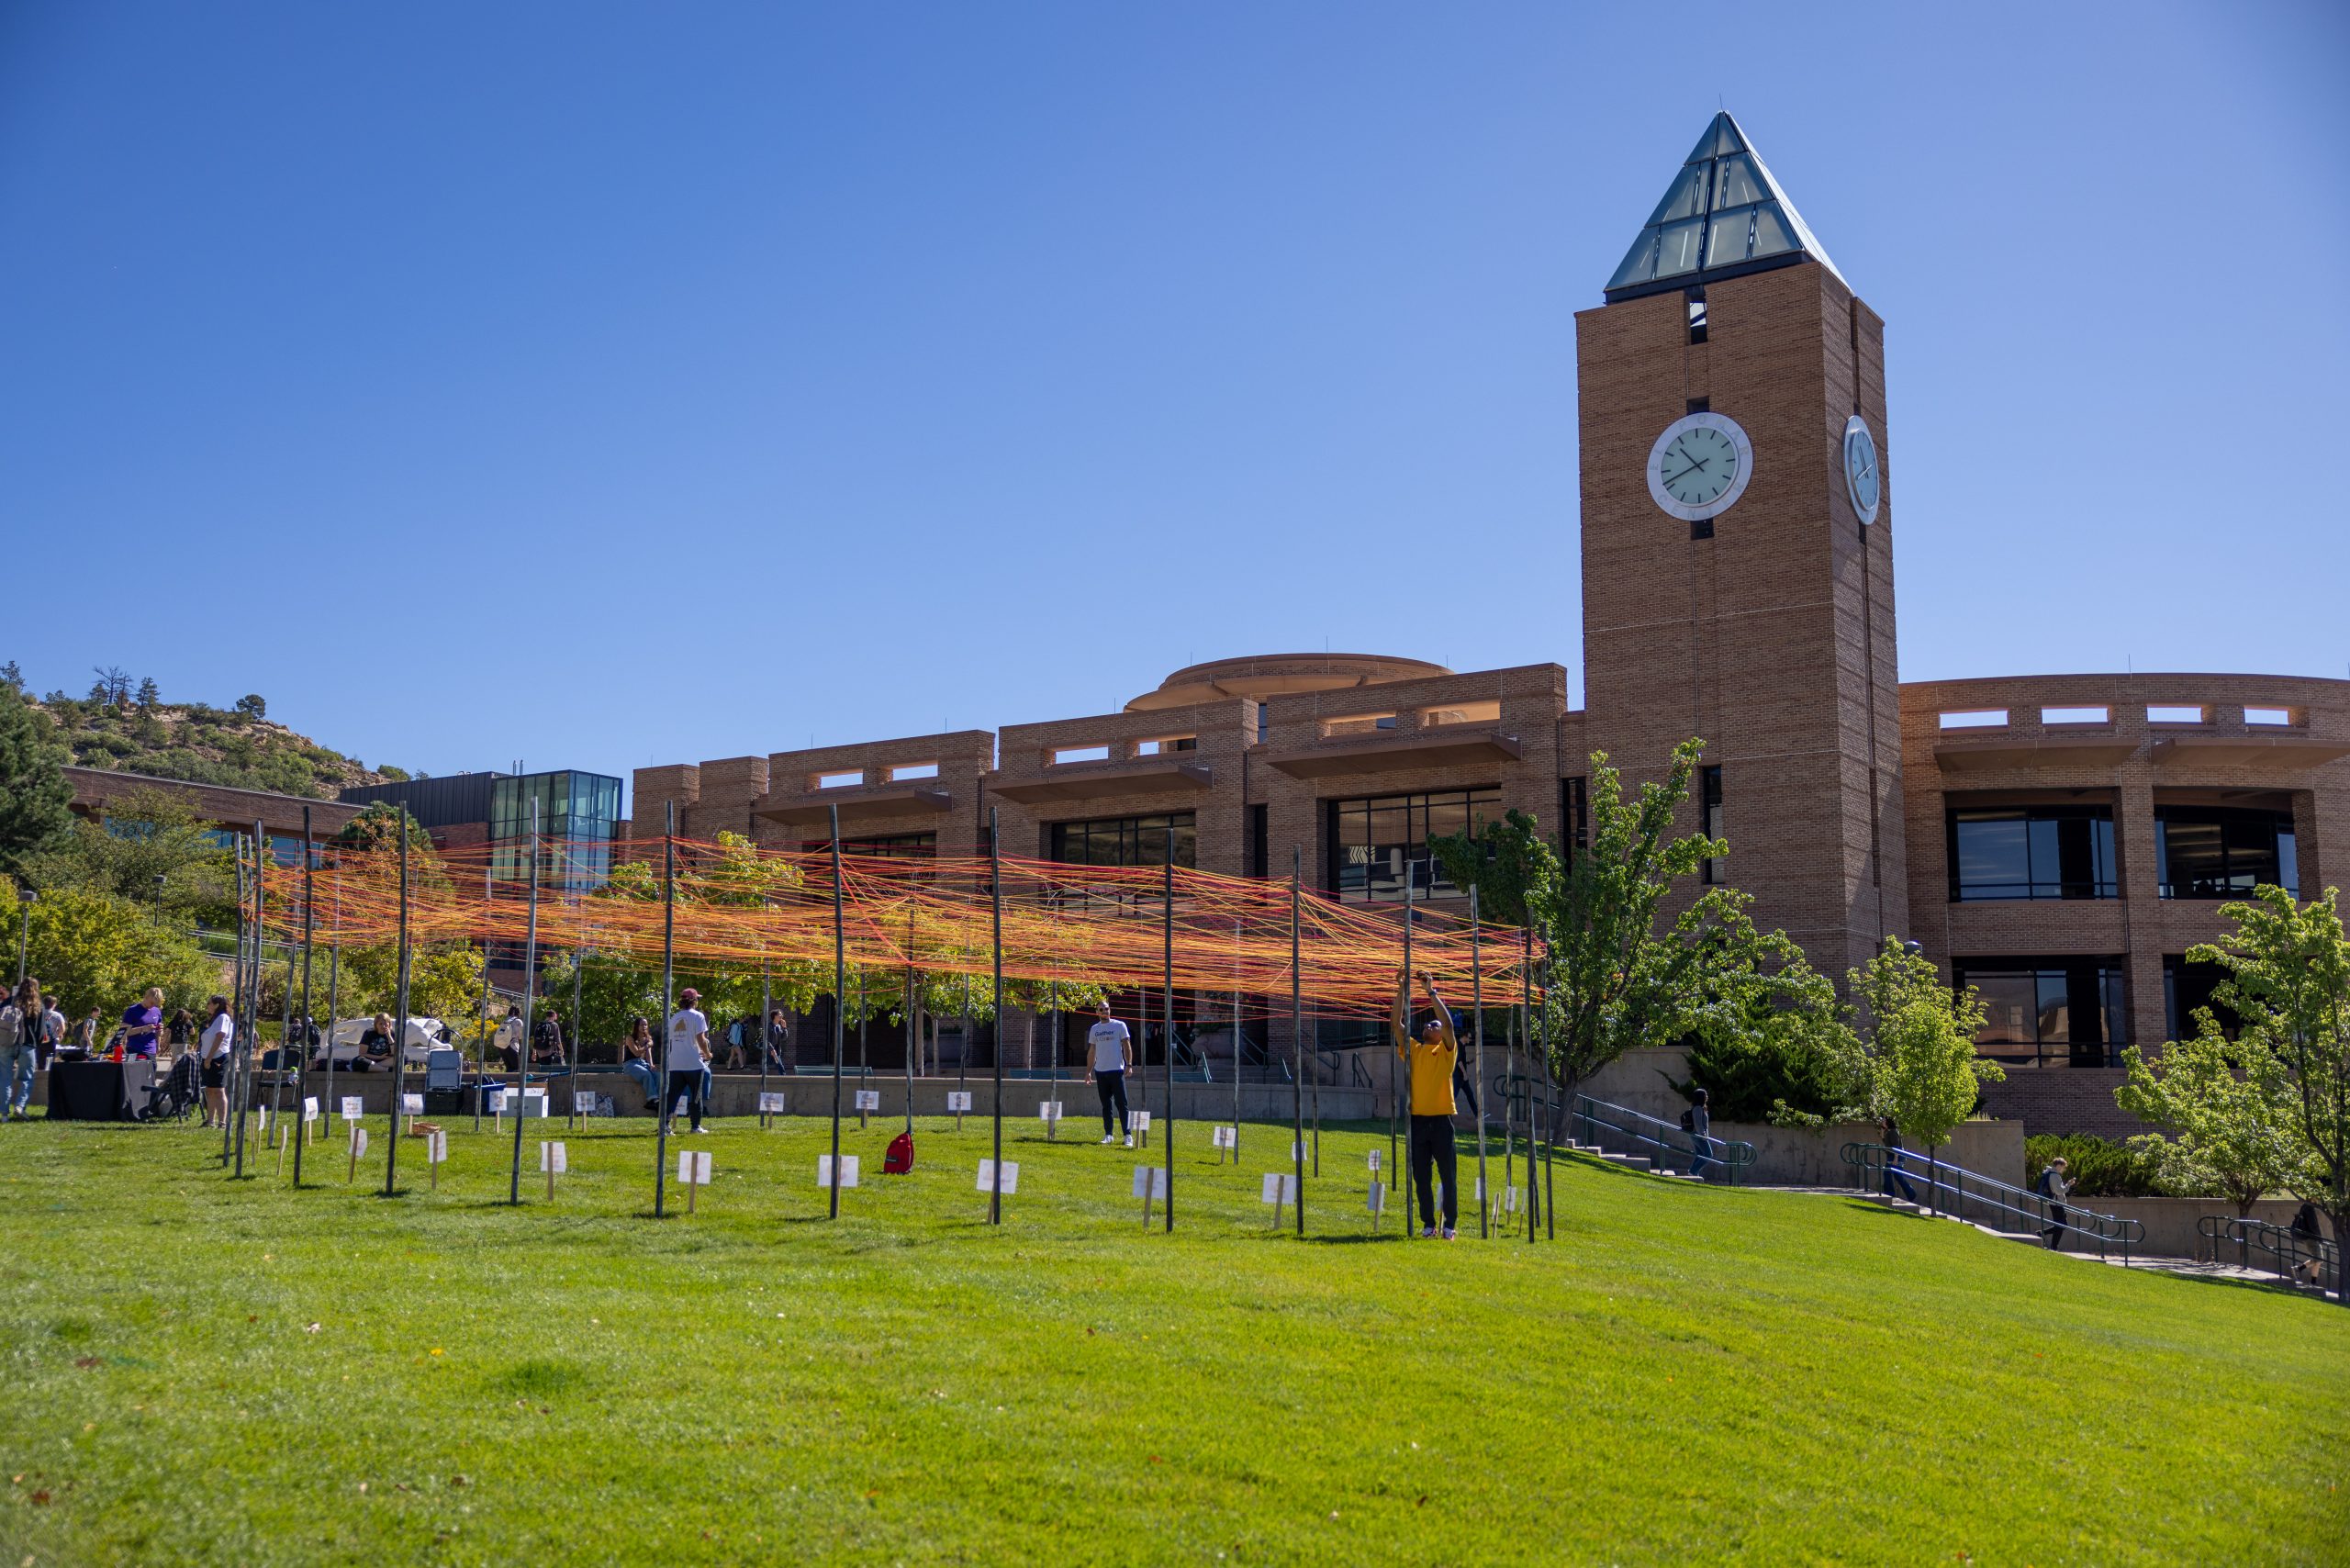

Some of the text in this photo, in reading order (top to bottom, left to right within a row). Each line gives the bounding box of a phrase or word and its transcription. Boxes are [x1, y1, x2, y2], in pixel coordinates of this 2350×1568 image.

[1650, 414, 1749, 471] EL POMAR
[1657, 482, 1744, 520] CENTER
